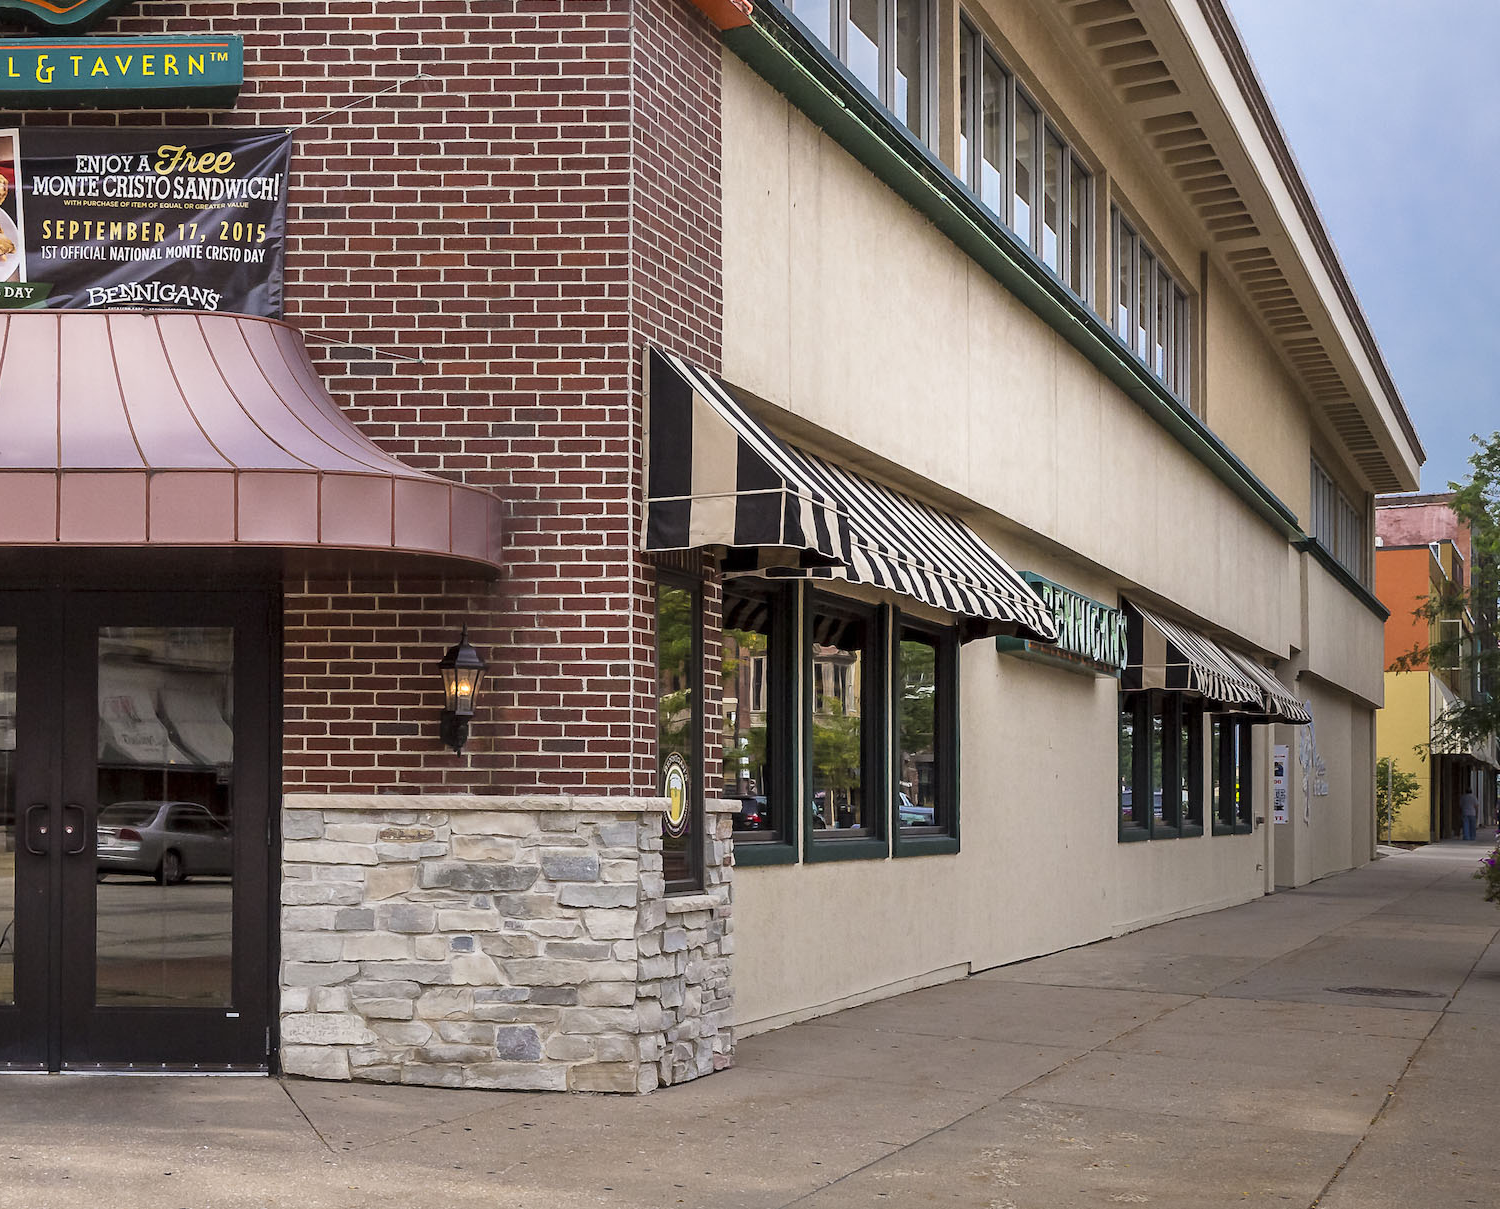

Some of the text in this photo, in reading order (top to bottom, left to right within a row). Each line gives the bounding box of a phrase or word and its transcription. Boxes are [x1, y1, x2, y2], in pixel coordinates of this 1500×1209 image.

[35, 54, 56, 84] &
[75, 144, 236, 175] ENJOY A Free
[32, 175, 99, 197] MONTE
[102, 175, 171, 200] CRISTO
[63, 199, 82, 207] WITH
[83, 200, 119, 208] PURCHASE
[130, 201, 147, 209] ITEM
[148, 201, 158, 209] OF
[159, 202, 182, 210] EQUAL
[184, 202, 194, 210] OR
[227, 201, 249, 209] VALUE
[42, 220, 266, 244] SEPTEMBER 17, 2015
[41, 245, 266, 263] 1ST OFFICIAL NATIONAL MONTE CRISTO DAY
[3, 285, 34, 300] DAY
[86, 281, 221, 311] BENNIGAN'S
